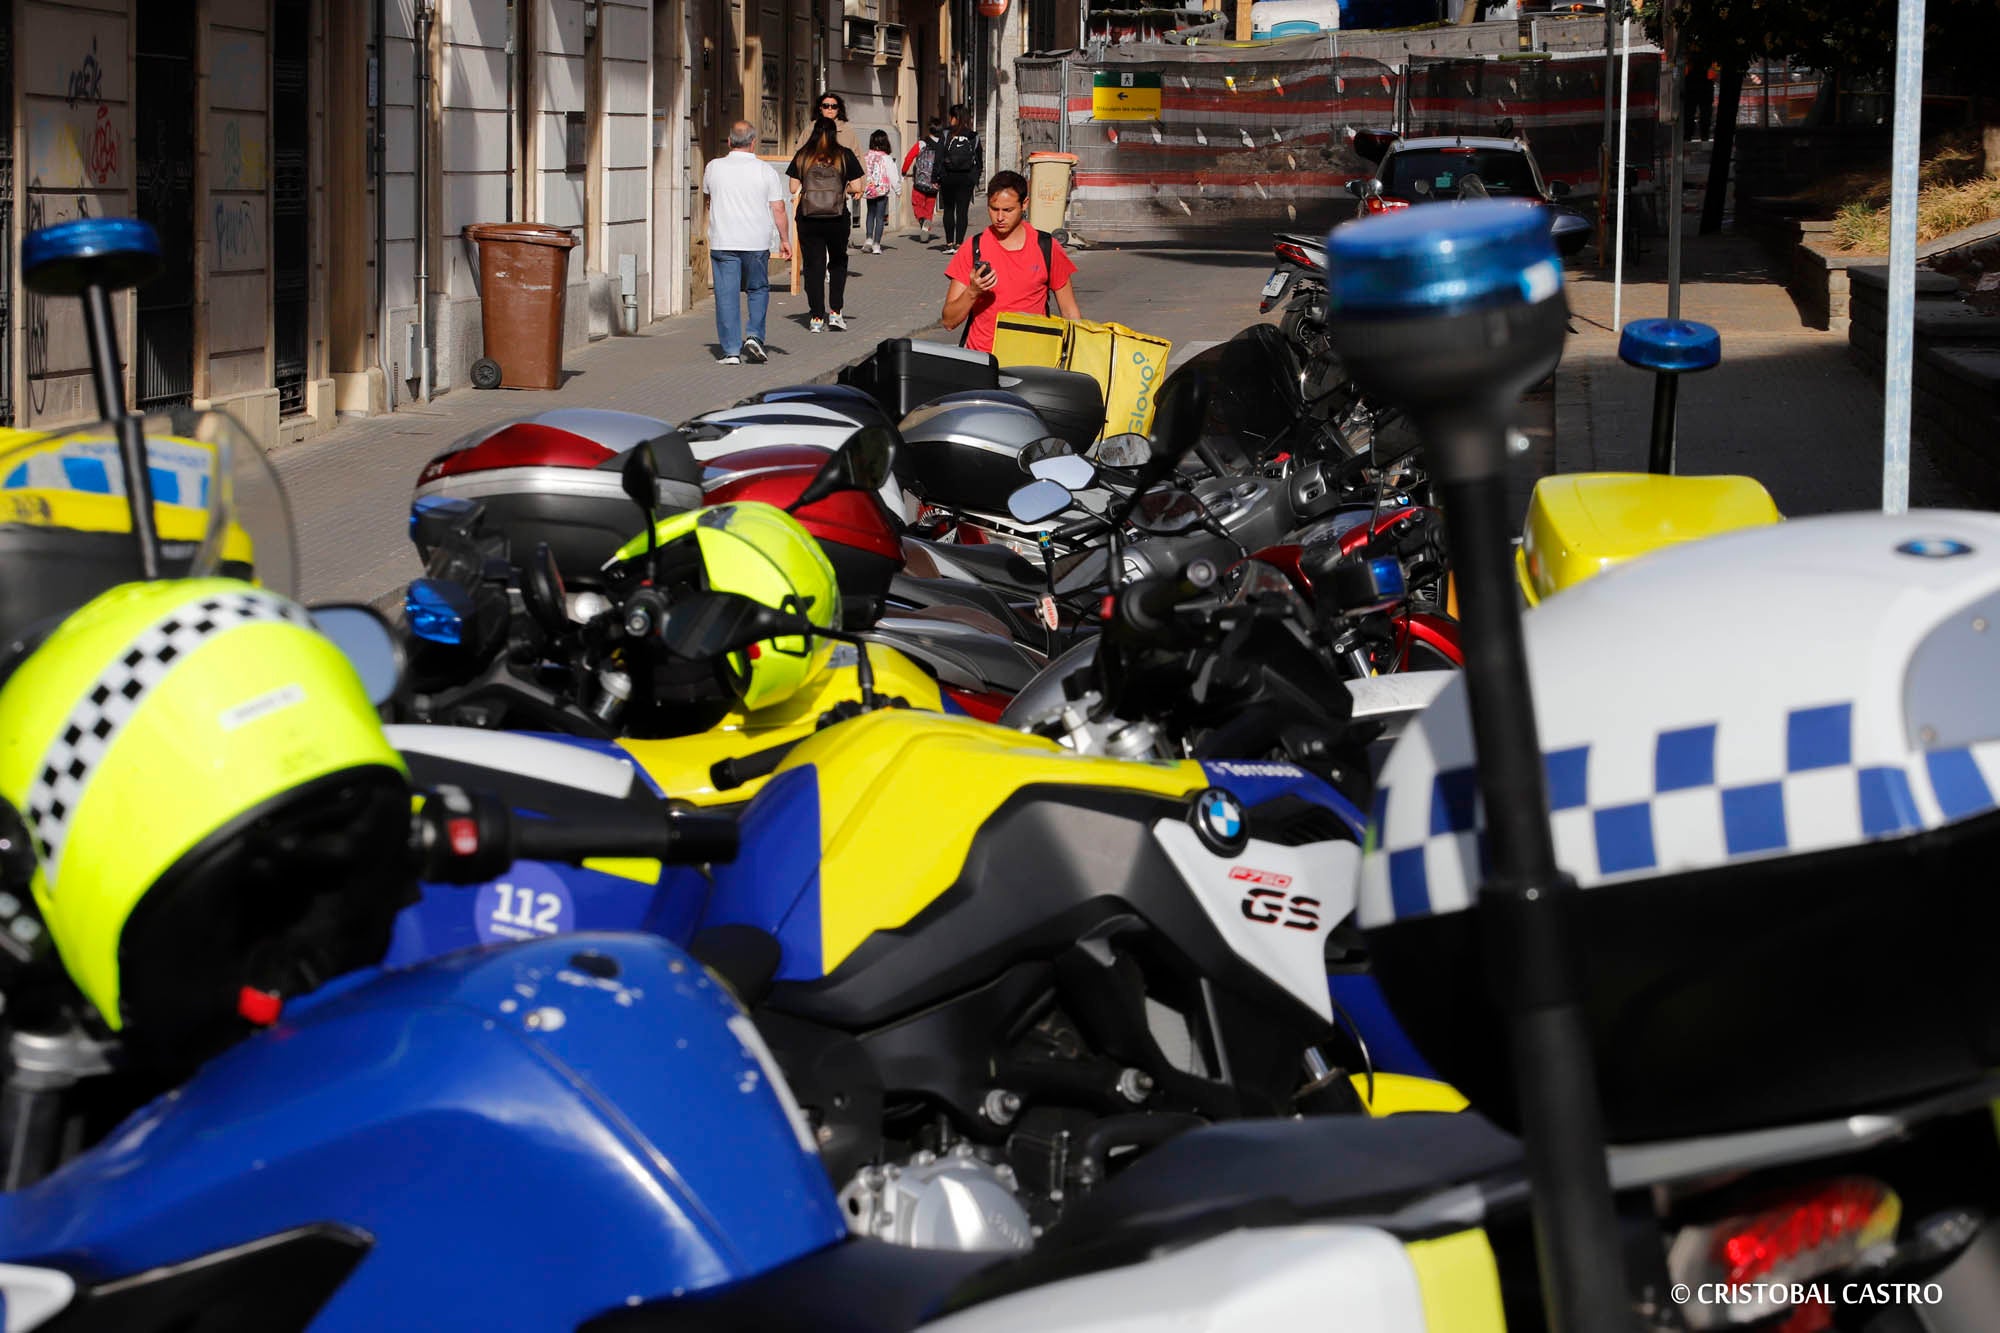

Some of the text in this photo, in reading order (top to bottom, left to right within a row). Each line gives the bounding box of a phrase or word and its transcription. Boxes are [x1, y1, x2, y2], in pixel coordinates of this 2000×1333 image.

[1128, 365, 1154, 434] Glovo
[492, 883, 561, 934] 112
[1241, 888, 1320, 931] GS
